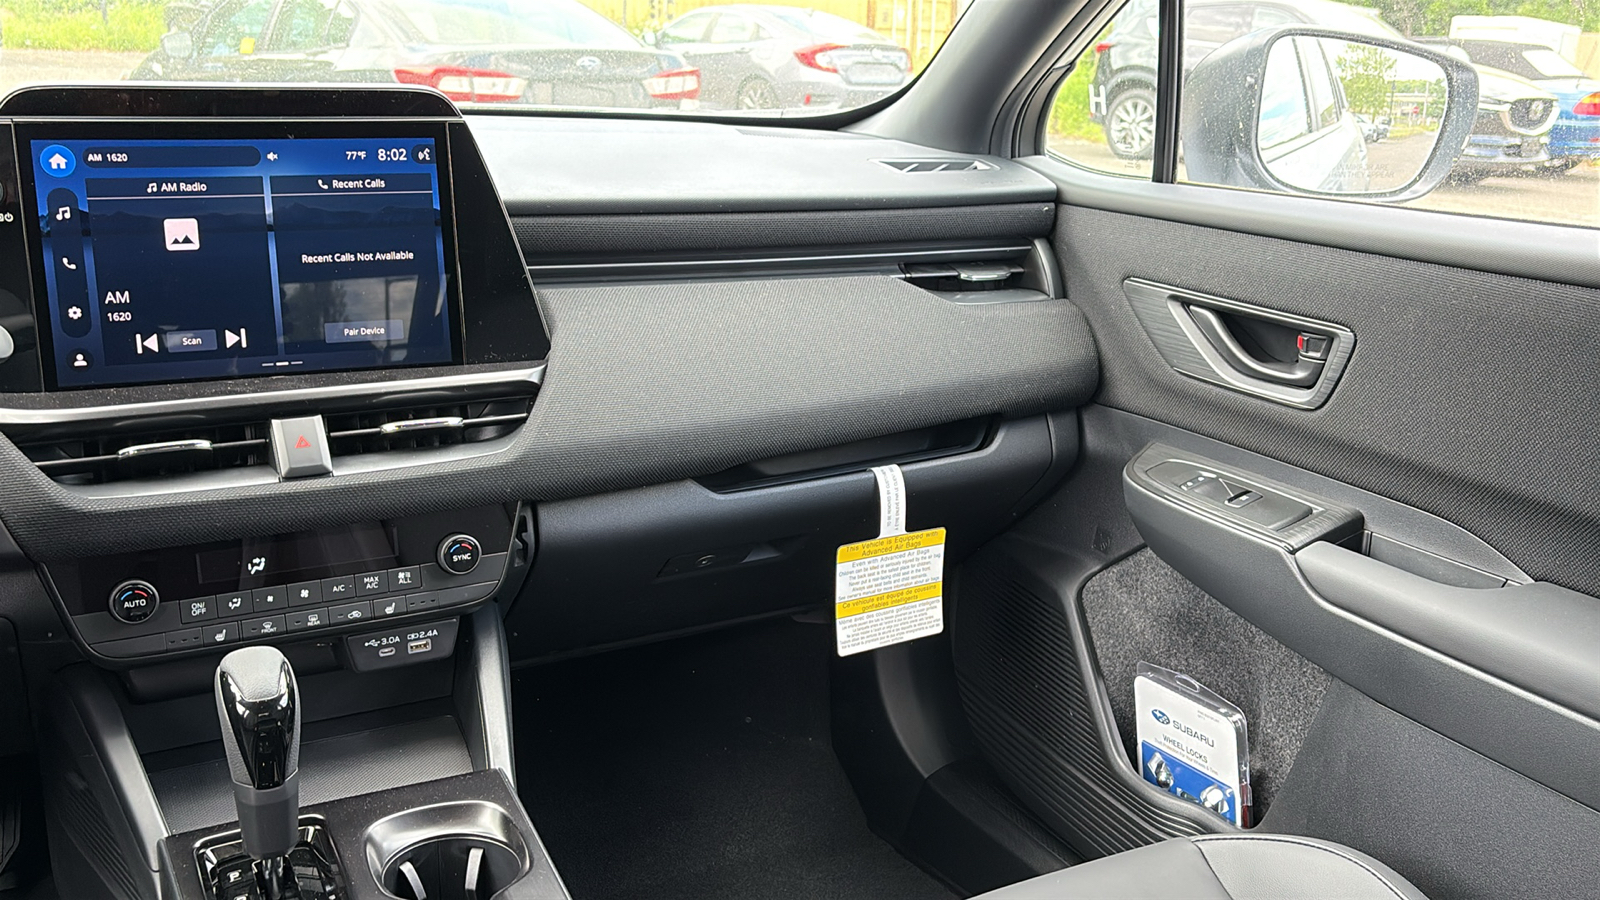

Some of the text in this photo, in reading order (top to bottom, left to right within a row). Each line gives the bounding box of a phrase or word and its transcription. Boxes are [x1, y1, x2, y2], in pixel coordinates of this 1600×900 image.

[1088, 84, 1107, 115] H
[88, 153, 128, 162] AM 1620
[377, 148, 407, 161] 8:02
[160, 182, 207, 192] AM Radio
[332, 178, 386, 189] Recent Calls
[301, 250, 414, 264] Recent Calls Not Available
[104, 290, 130, 304] AM
[107, 312, 132, 322] 1620
[344, 326, 385, 336] Pair Device
[182, 337, 202, 346] Scan
[862, 540, 884, 549] Vehicle
[894, 534, 923, 543] Equipped
[862, 547, 892, 557] Advanced
[906, 541, 921, 549] Bags
[452, 553, 472, 562] SYNC
[852, 560, 866, 568] Even
[880, 553, 906, 562] Advanced
[398, 576, 412, 584] ALL
[332, 584, 346, 593] A/C
[366, 582, 378, 590] A/C
[914, 583, 936, 594] coussins
[123, 598, 147, 608] AUTO
[862, 594, 918, 612] gonflables intelligents
[875, 609, 894, 617] coussins
[896, 604, 917, 613] gonflables
[918, 599, 940, 608] intelligents
[192, 608, 207, 616] OFF
[420, 628, 438, 639] 2.4A
[381, 635, 400, 646] 3.0A
[1172, 720, 1214, 748] SUBARU
[1162, 734, 1208, 763] WHEEL LOCKS
